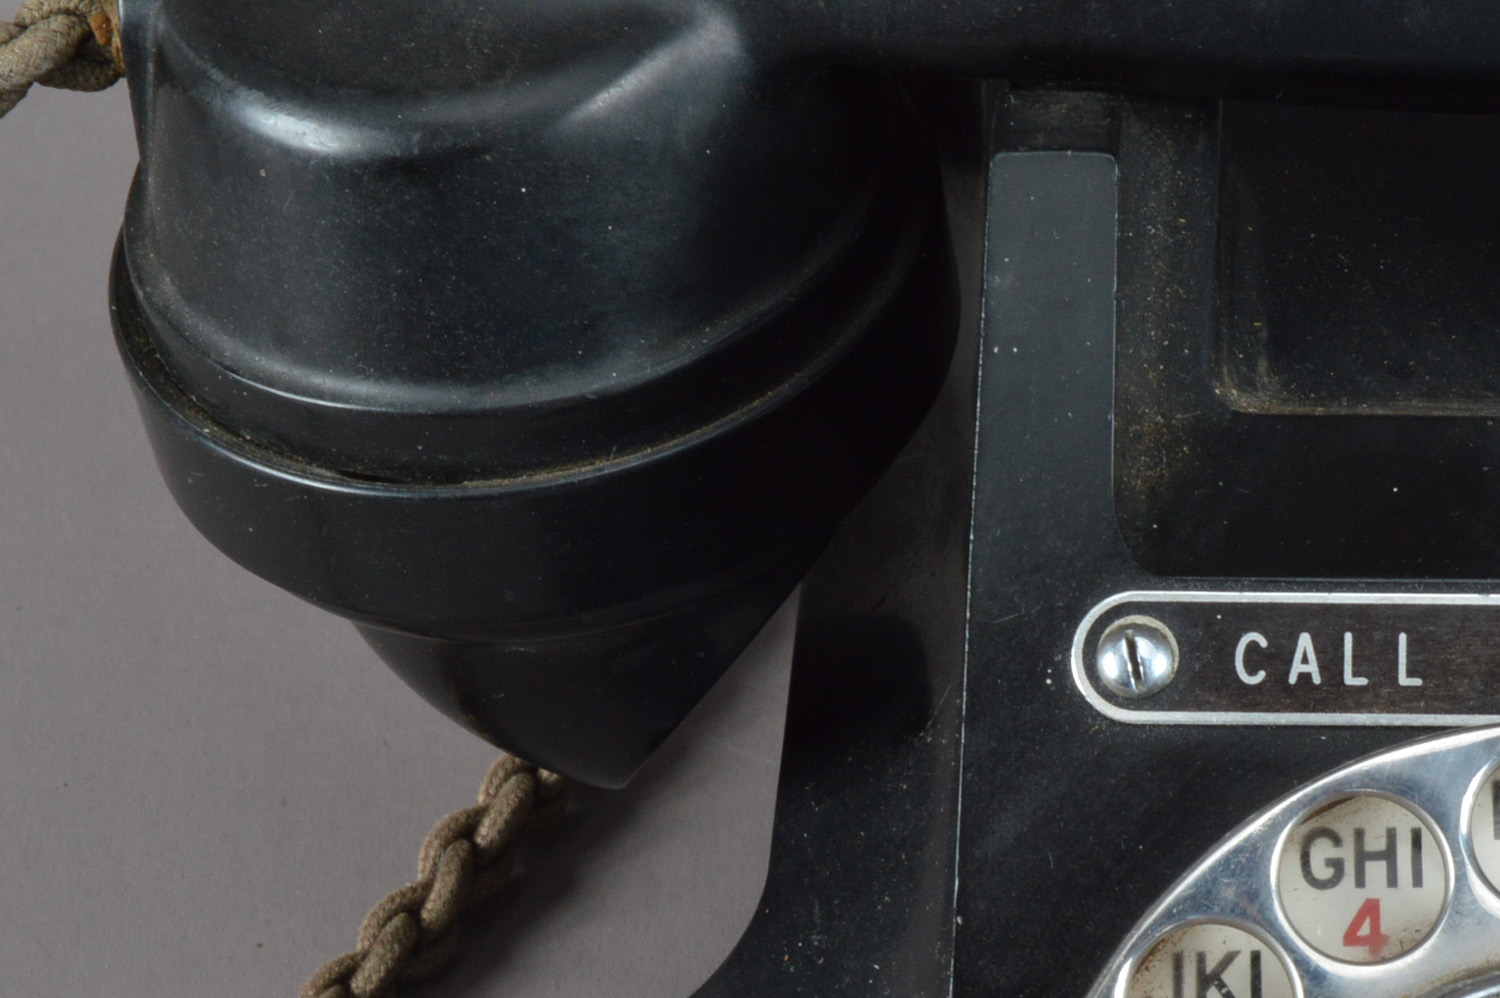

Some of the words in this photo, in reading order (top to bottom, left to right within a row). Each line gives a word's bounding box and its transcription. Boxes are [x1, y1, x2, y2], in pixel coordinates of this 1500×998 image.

[1234, 631, 1423, 687] CALL
[1300, 826, 1423, 890] GHI
[1342, 898, 1389, 960] 4
